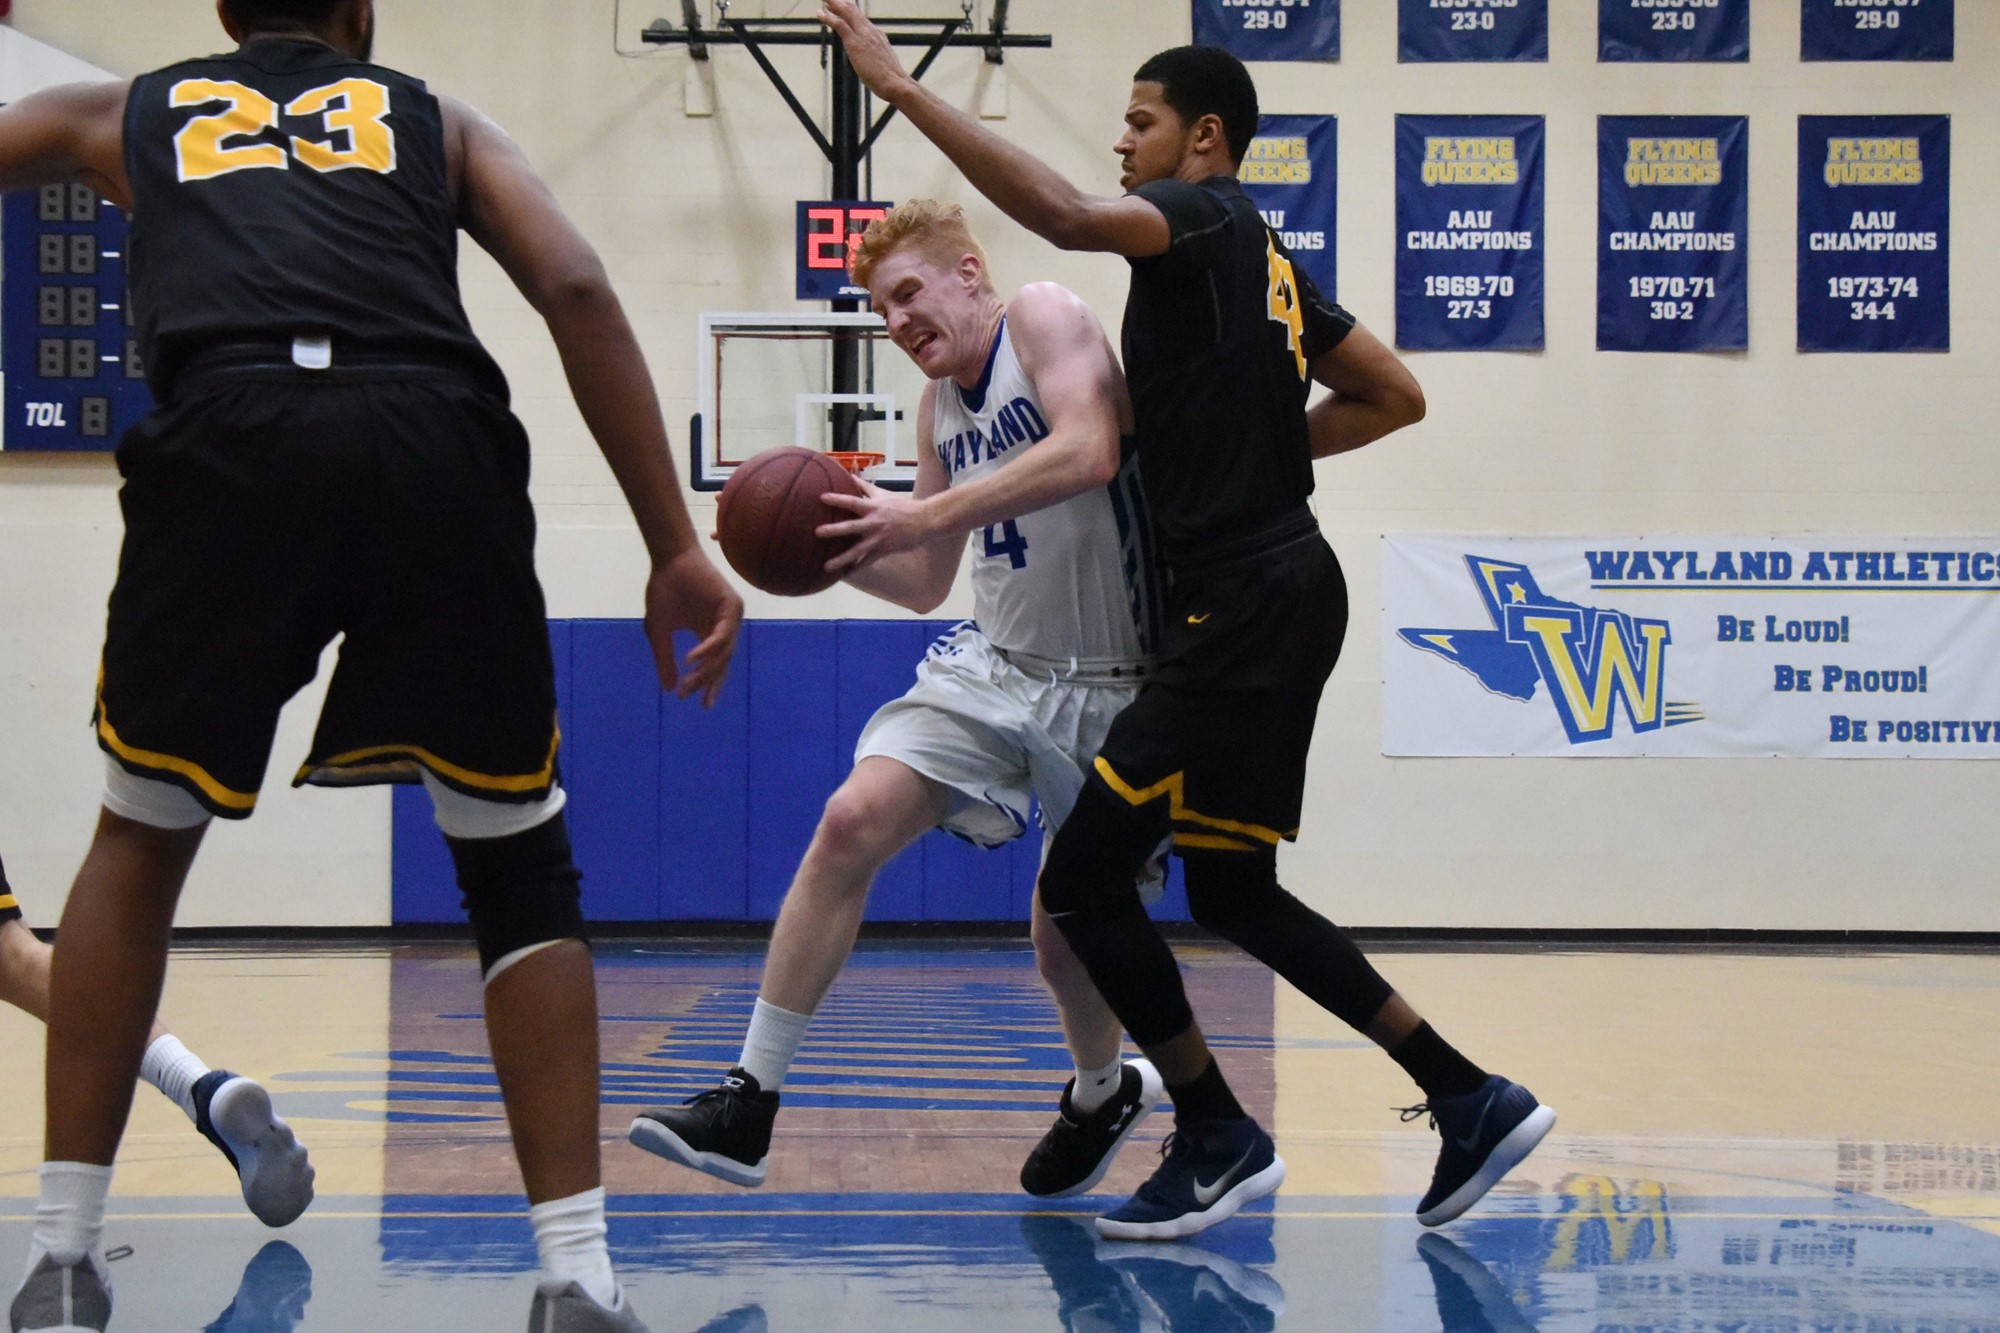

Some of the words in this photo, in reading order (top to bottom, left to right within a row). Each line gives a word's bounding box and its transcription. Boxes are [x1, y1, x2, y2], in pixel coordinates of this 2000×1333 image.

[1244, 11, 1286, 28] 29-0
[1452, 12, 1494, 29] 23-0
[1653, 12, 1694, 29] 23-0
[1856, 11, 1899, 28] 29-0
[169, 77, 397, 183] 23
[1425, 137, 1515, 161] FLYING
[1628, 138, 1718, 161] FLYING
[1828, 138, 1919, 161] FLYING
[1422, 160, 1519, 186] QUEENS
[1625, 160, 1721, 186] QUEENS
[1826, 160, 1922, 186] QUEENS
[1447, 211, 1492, 228] AAU
[1650, 212, 1695, 229] AAU
[1851, 212, 1895, 229] AAU
[1408, 232, 1531, 249] CHAMPIONS
[1611, 232, 1734, 250] CHAMPIONS
[1811, 233, 1936, 250] CHAMPIONS
[1425, 276, 1513, 296] 1969-70
[1629, 277, 1715, 297] 1970-71
[1829, 277, 1918, 297] 1973-74
[1448, 301, 1490, 318] 27-3
[1651, 302, 1693, 319] 30-2
[1851, 302, 1895, 319] 34-4
[26, 403, 65, 426] TOL
[938, 397, 1050, 480] WAYLAND
[983, 518, 1028, 569] 4
[1585, 552, 1791, 580] WAYLAND
[1803, 552, 2000, 581] ATHLETIC
